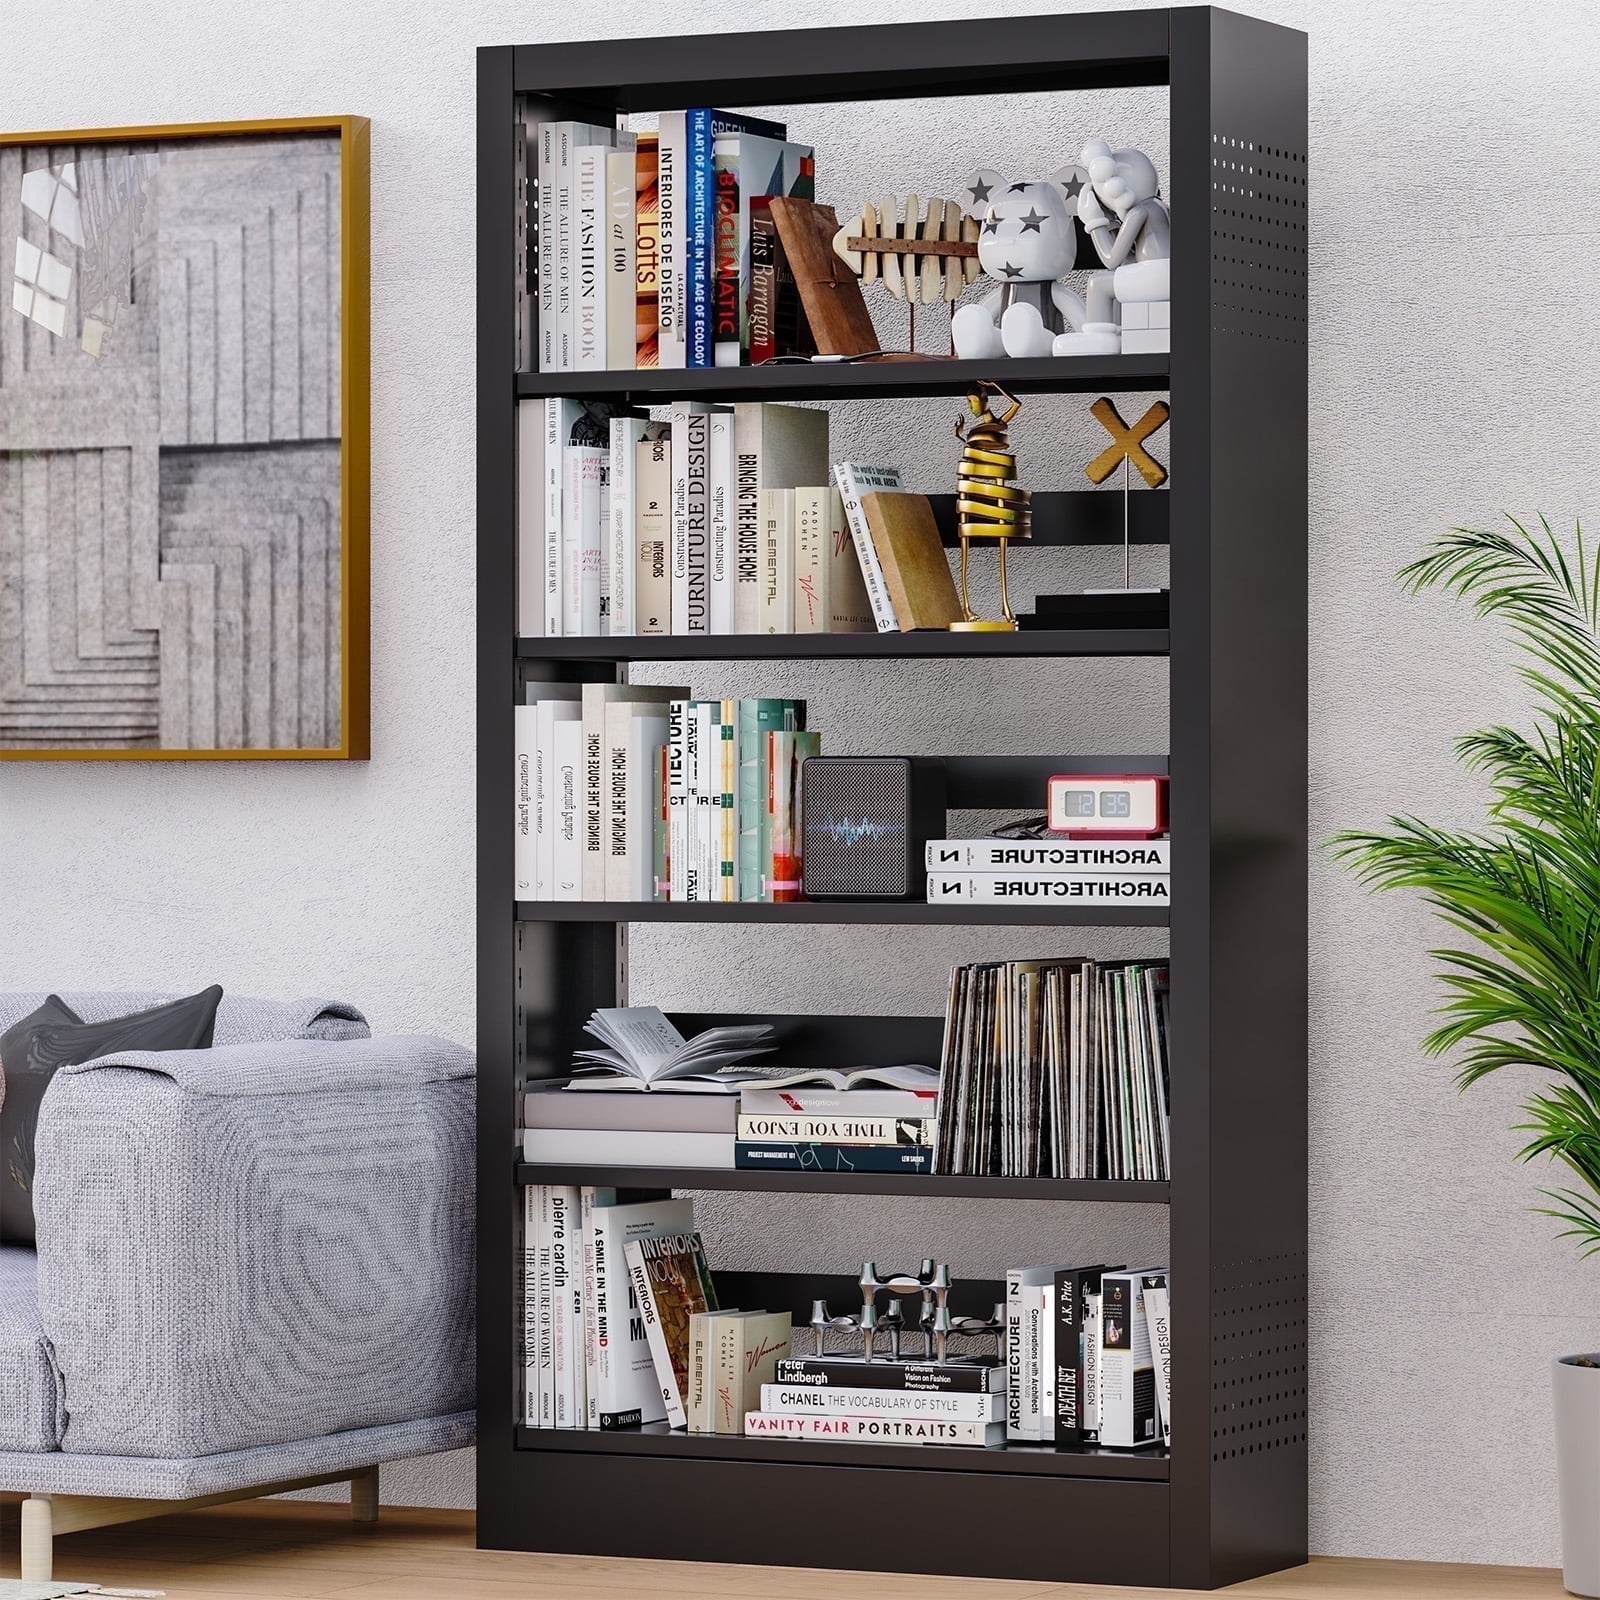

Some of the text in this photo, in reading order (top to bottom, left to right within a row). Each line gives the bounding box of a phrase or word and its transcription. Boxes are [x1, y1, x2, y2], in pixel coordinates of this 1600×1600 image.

[612, 182, 630, 219] AD
[543, 184, 552, 311] THE ALLURE OF MEN
[560, 186, 569, 313] THE ALLURE OF MEN
[661, 148, 675, 328] INTERIORES DE DISEÑO
[694, 111, 705, 365] THE ART OF ARCHITECTURE IN THE AGE OF ECOLOGY
[719, 173, 735, 334] BIOCLIMATIC
[581, 156, 595, 359] THE FASHION BOOK
[613, 248, 626, 272] 100
[750, 219, 775, 347] Luis Barragán
[864, 476, 872, 487] by
[649, 501, 658, 510] 2
[688, 415, 705, 631] FURNITURE DESIGN
[738, 454, 757, 583] BRINGING THE HOUSE HOME
[674, 478, 688, 579] Constructing Paradies
[712, 486, 727, 582] Constructing Paradies
[548, 530, 557, 594] THE ALLURE OF MEN
[652, 541, 664, 578] INTERIORS
[767, 520, 777, 606] ELEMENTAL
[649, 617, 658, 626] 2
[1078, 793, 1128, 815] 12 35
[746, 1121, 886, 1138] TIME YOU ENJOY
[552, 1197, 569, 1288] pierre cardin
[594, 1228, 603, 1236] A
[640, 1233, 699, 1259] INTERIORS
[584, 1243, 593, 1263] Linda
[595, 1239, 605, 1274] SMILE
[597, 1277, 606, 1289] IN
[633, 1266, 656, 1324] INTERIORS
[1010, 1282, 1019, 1295] N
[526, 1246, 536, 1369] THE ALLURE OF WOMEN
[540, 1246, 550, 1369] THE ALLURE OF WOMEN
[597, 1292, 607, 1313] THE
[1060, 1280, 1073, 1325] A.K. Price
[598, 1316, 608, 1347] MIND
[1155, 1317, 1170, 1355] DESIGN
[556, 1335, 564, 1371] INNOVATION
[746, 1336, 788, 1373] Women
[777, 1360, 806, 1370] Peter
[1031, 1308, 1039, 1415] Conversations with Architects
[1087, 1333, 1096, 1406] FASHION DESIGN
[694, 1340, 703, 1409] ELEMENTAL
[777, 1370, 829, 1386] Lindbergh
[904, 1373, 922, 1382] Vision
[929, 1374, 952, 1383] Fashion
[904, 1382, 940, 1391] Photography
[1009, 1316, 1020, 1430] ARCHITECTURE
[662, 1388, 671, 1401] 2
[780, 1392, 958, 1411] CHANEL THE VOCABULARY OF STYLE
[977, 1395, 985, 1418] Yale
[1058, 1365, 1076, 1429] the DEATH BET
[749, 1418, 957, 1437] VANITY FAIR PORTRAITS
